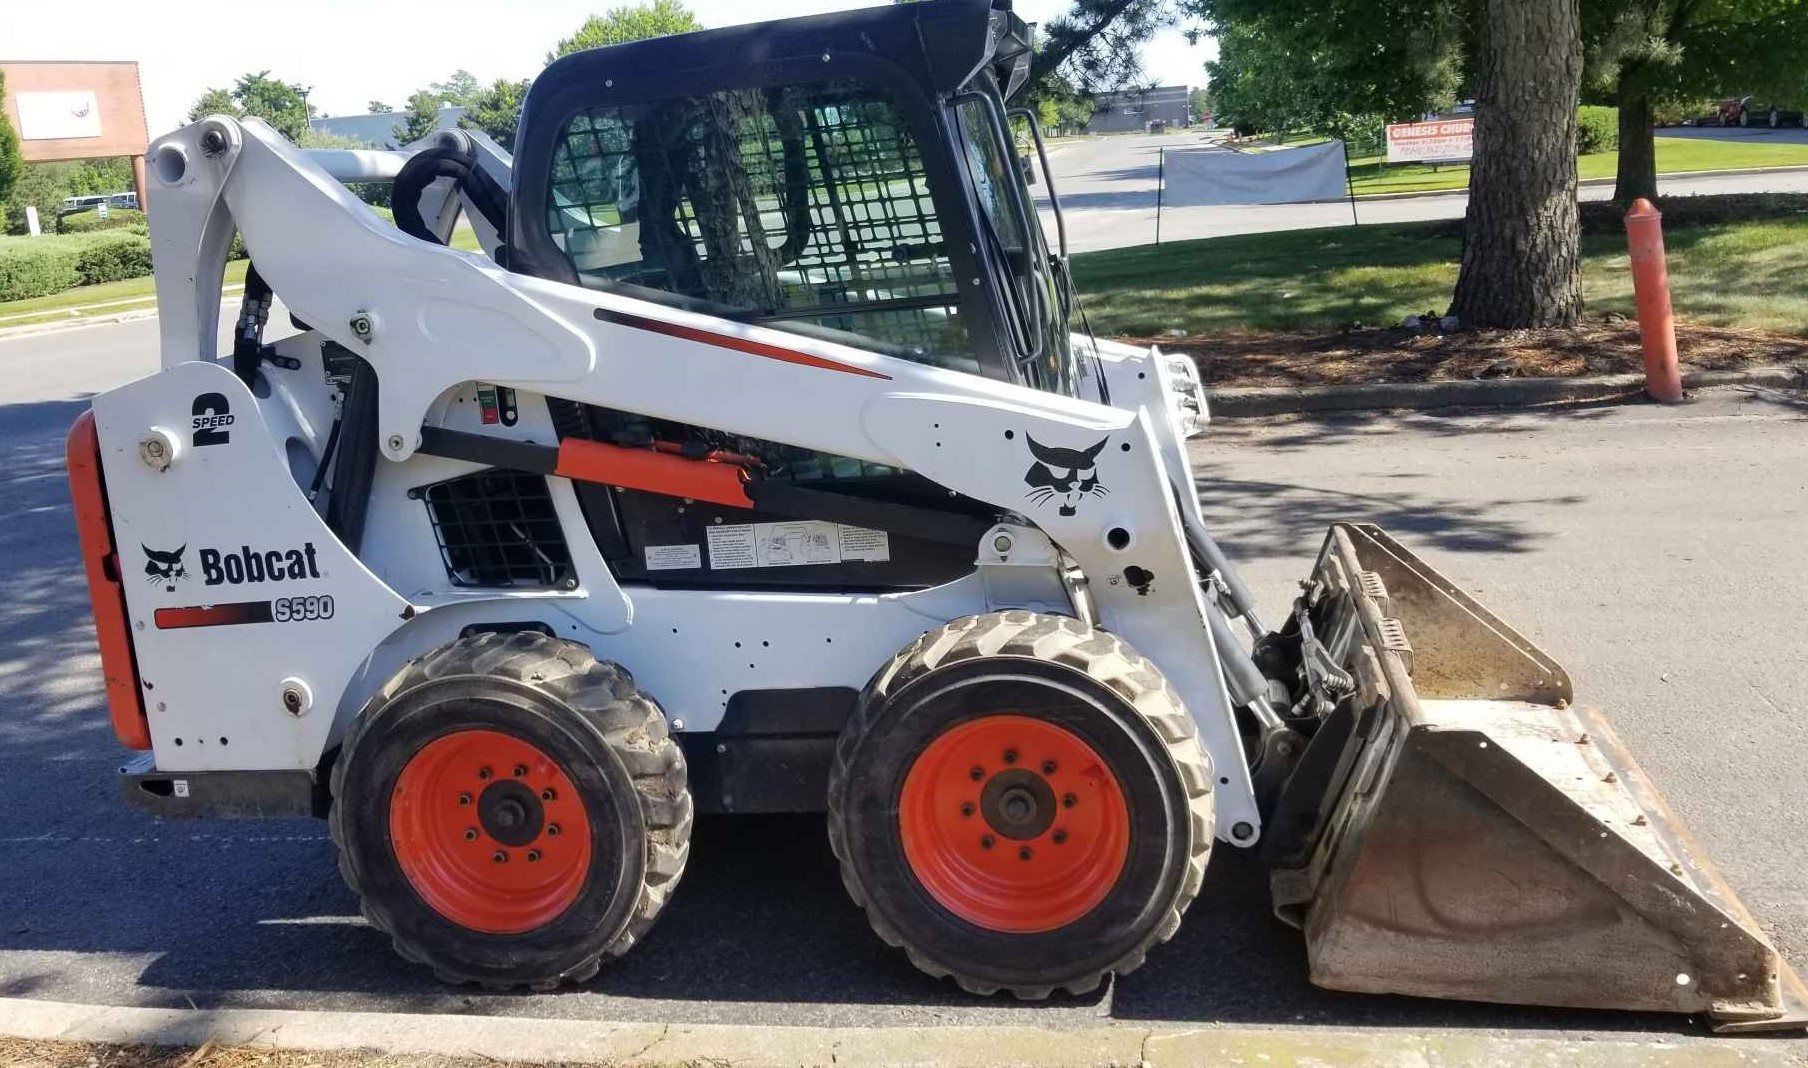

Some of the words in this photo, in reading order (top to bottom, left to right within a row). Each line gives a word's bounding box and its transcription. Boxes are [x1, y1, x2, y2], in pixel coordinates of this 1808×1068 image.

[1392, 125, 1439, 138] GENESIS
[1441, 122, 1474, 135] CHUR
[192, 392, 230, 447] 2
[192, 415, 235, 429] SPEED
[199, 542, 321, 586] Bobcat
[275, 594, 335, 623] S590
